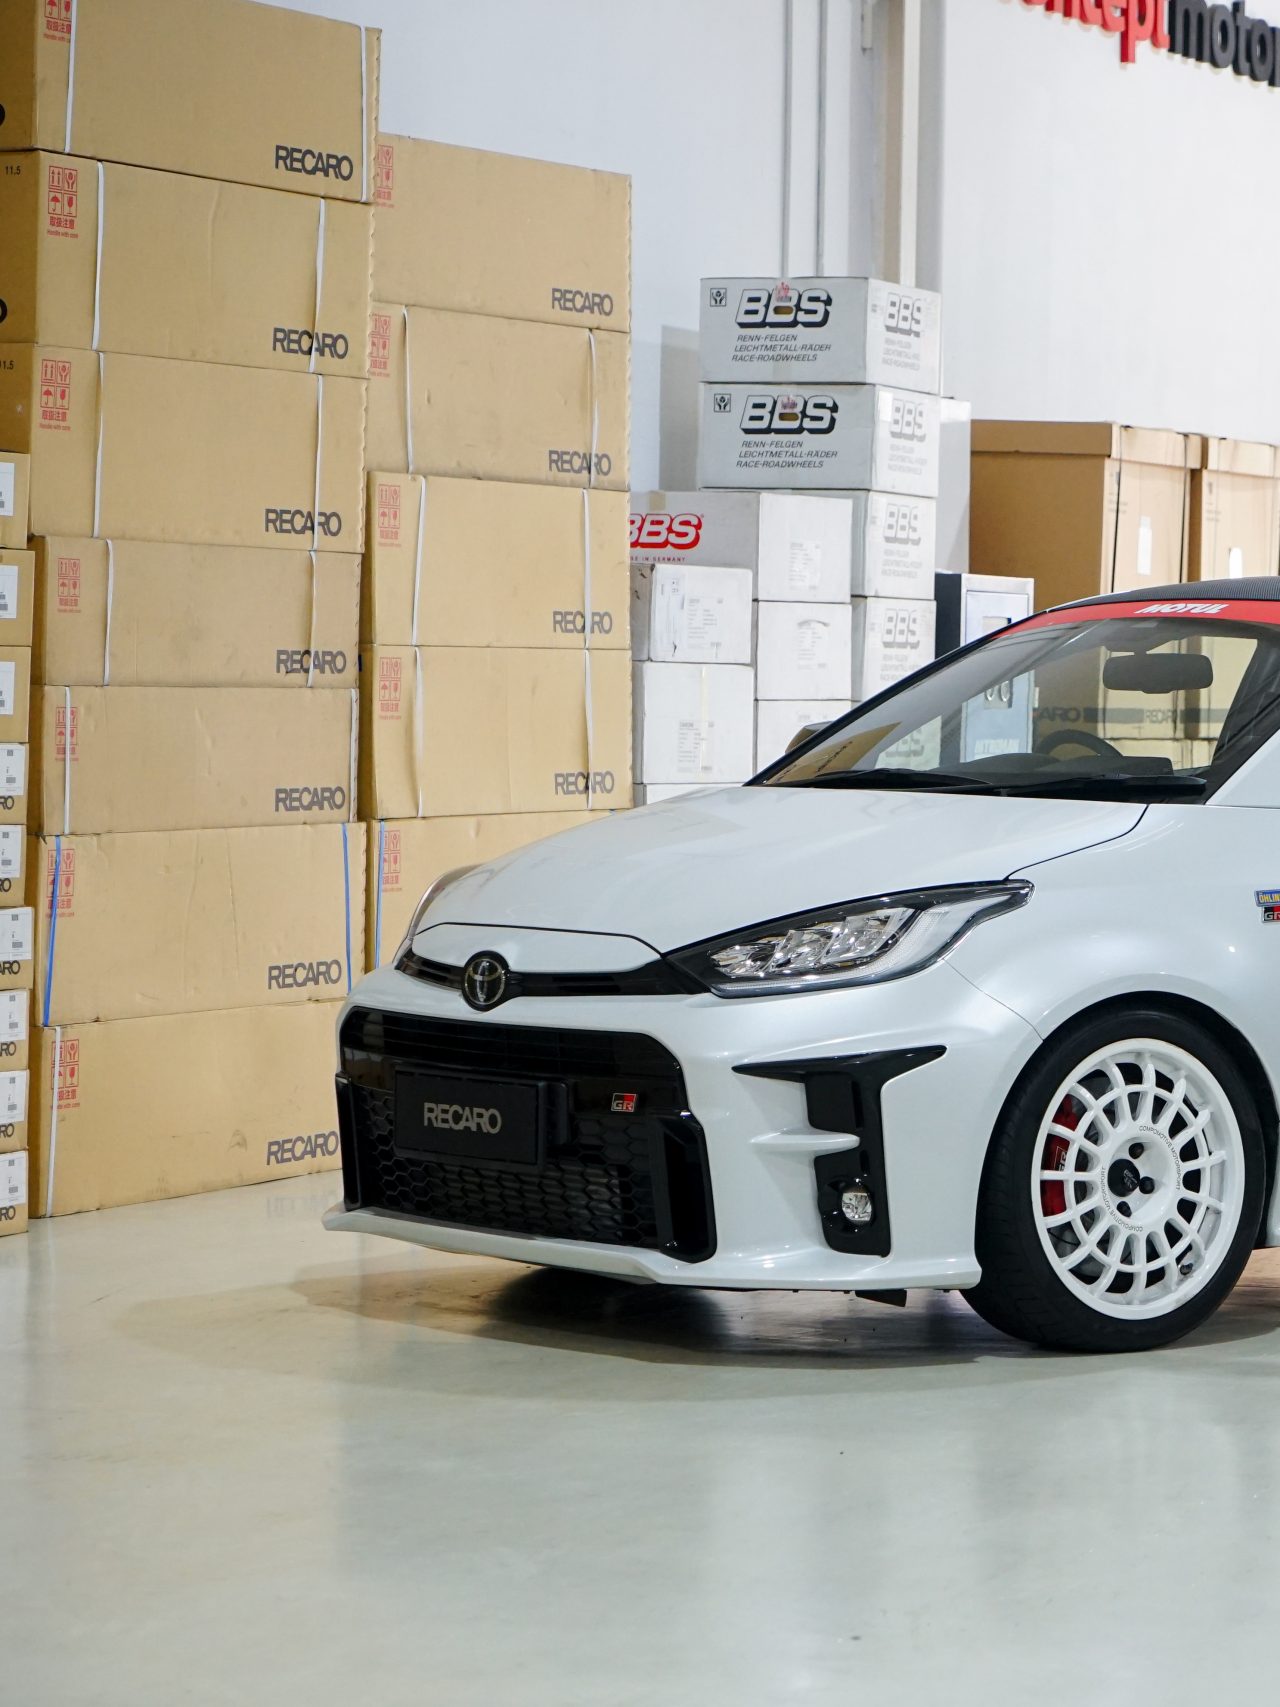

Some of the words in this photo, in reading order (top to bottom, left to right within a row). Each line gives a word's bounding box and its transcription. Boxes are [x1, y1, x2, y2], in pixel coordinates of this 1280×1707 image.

[5, 166, 21, 175] 11.5
[275, 145, 353, 181] RECARO
[551, 288, 613, 316] RECARO
[735, 288, 832, 328] BBS
[884, 291, 922, 338] BBS
[272, 328, 348, 359] RECARO
[737, 334, 798, 342] RENN-FELGEN
[740, 395, 839, 434] BBS
[742, 440, 803, 449] RENN-FELGEN
[549, 450, 611, 476] RECARO
[265, 508, 342, 537] RECARO
[553, 611, 613, 634] RECRO
[1134, 603, 1230, 614] MOTUL
[276, 650, 347, 674] RECARO
[275, 786, 345, 812] RECARO
[268, 959, 342, 990] RECARO
[424, 1102, 502, 1134] RECARO
[613, 1100, 633, 1111] GR
[267, 1131, 339, 1165] RECARO
